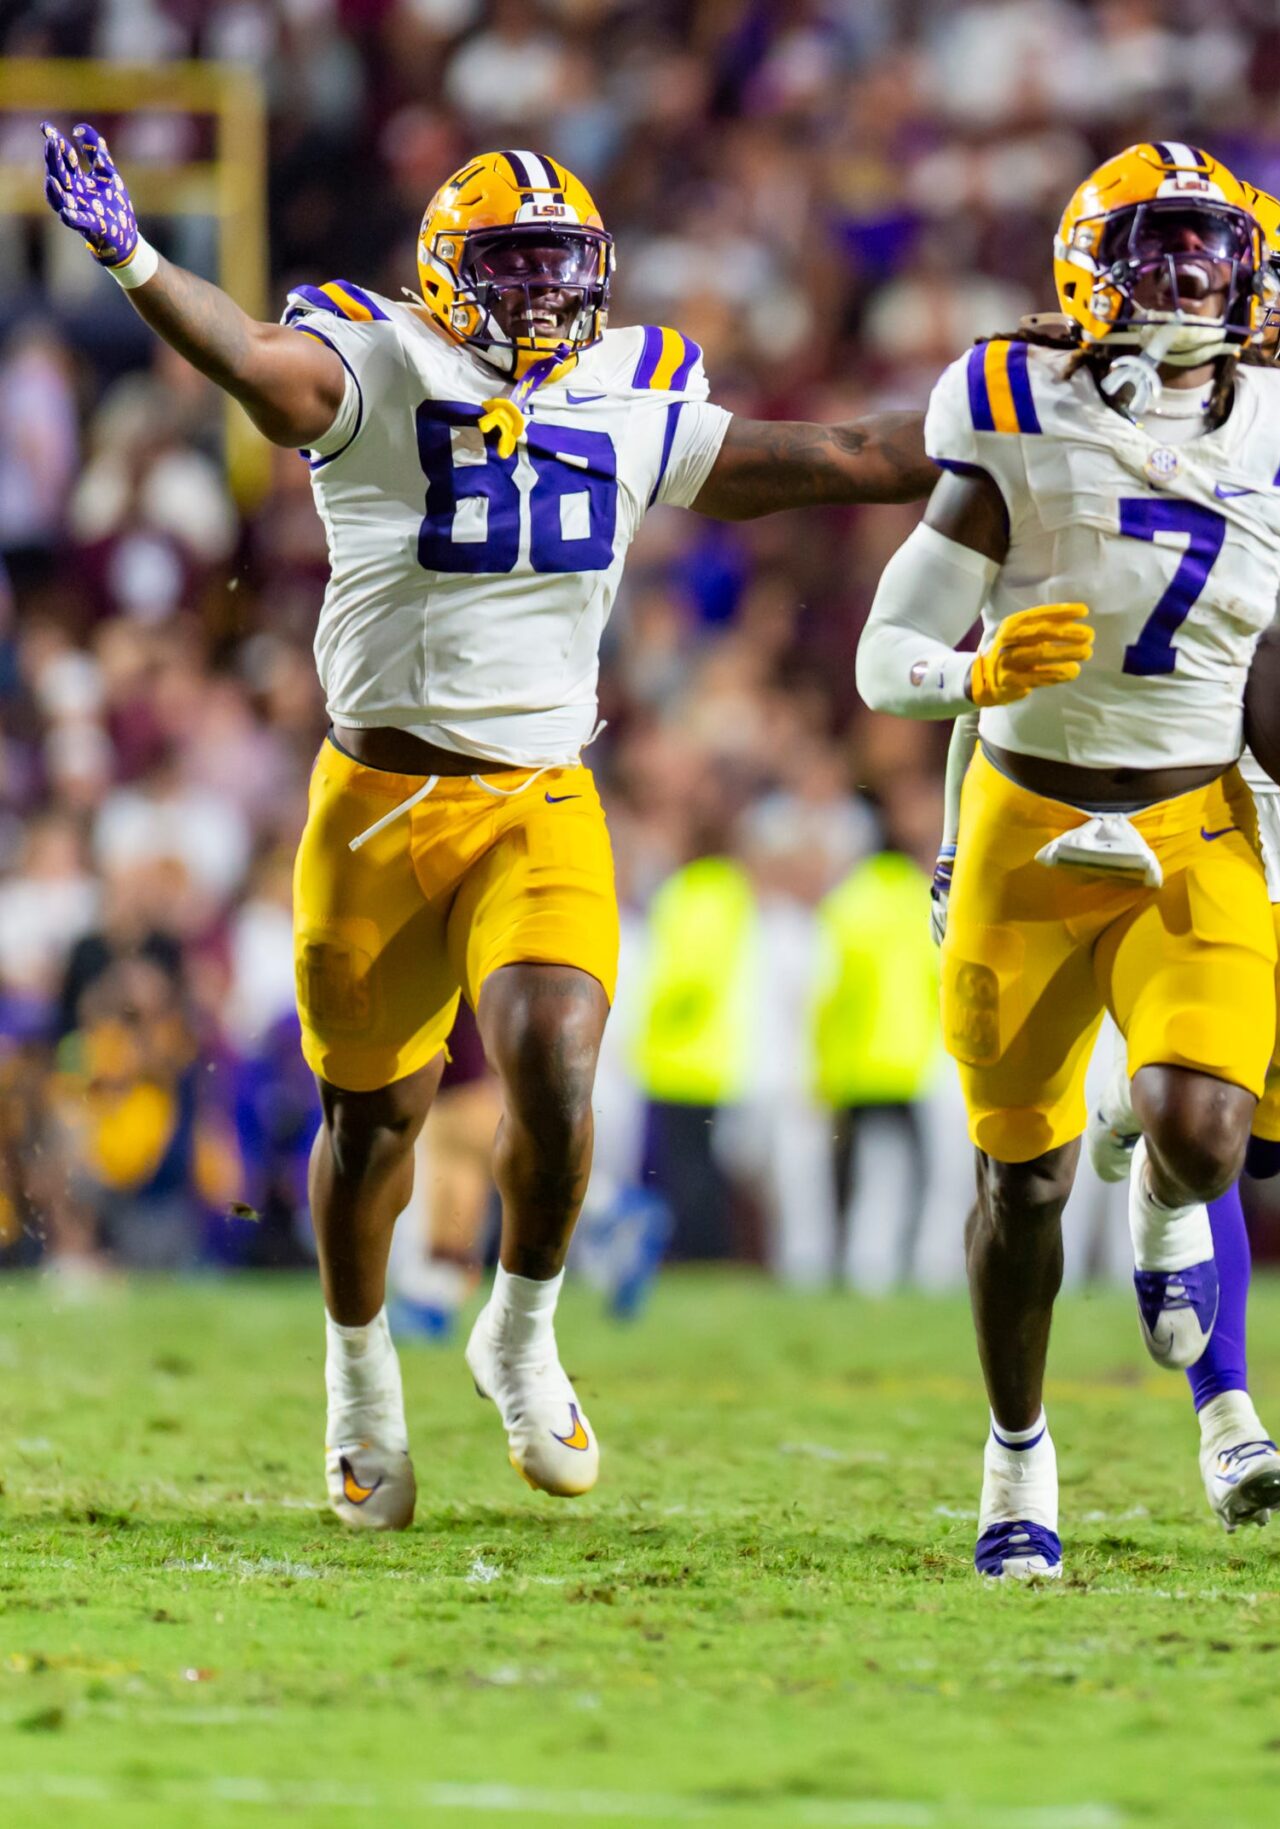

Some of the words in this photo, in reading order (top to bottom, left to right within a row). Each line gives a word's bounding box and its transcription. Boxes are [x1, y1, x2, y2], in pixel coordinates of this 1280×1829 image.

[532, 205, 566, 217] LSU
[416, 400, 617, 573] 88
[1120, 498, 1227, 676] 7
